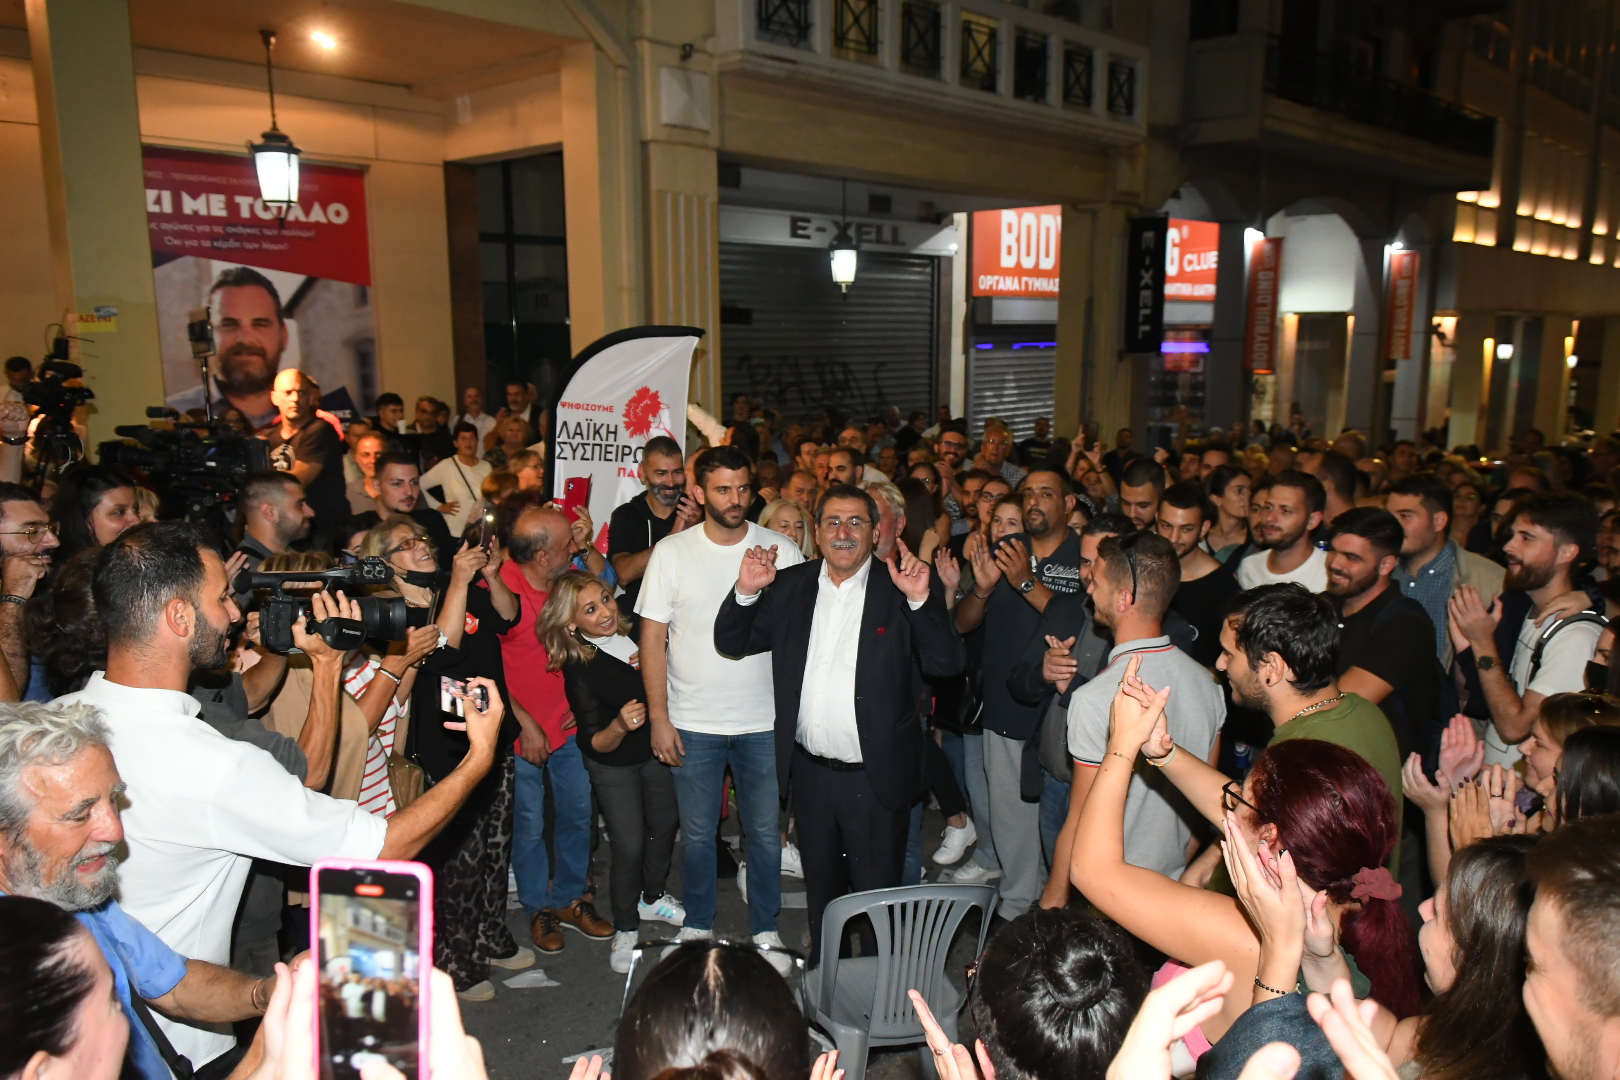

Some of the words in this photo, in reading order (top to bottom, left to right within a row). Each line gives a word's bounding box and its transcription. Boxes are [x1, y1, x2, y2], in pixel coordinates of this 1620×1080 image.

[181, 190, 228, 217] ΜΕ
[286, 201, 349, 225] ΛΑΟ
[978, 274, 1020, 291] ΟΡΓΑΝΑ
[560, 401, 614, 413] ΨΗΦΙΖΟΥΜΕ
[557, 418, 618, 442] ΛΑΪΚΗ
[342, 628, 361, 636] Panasonic
